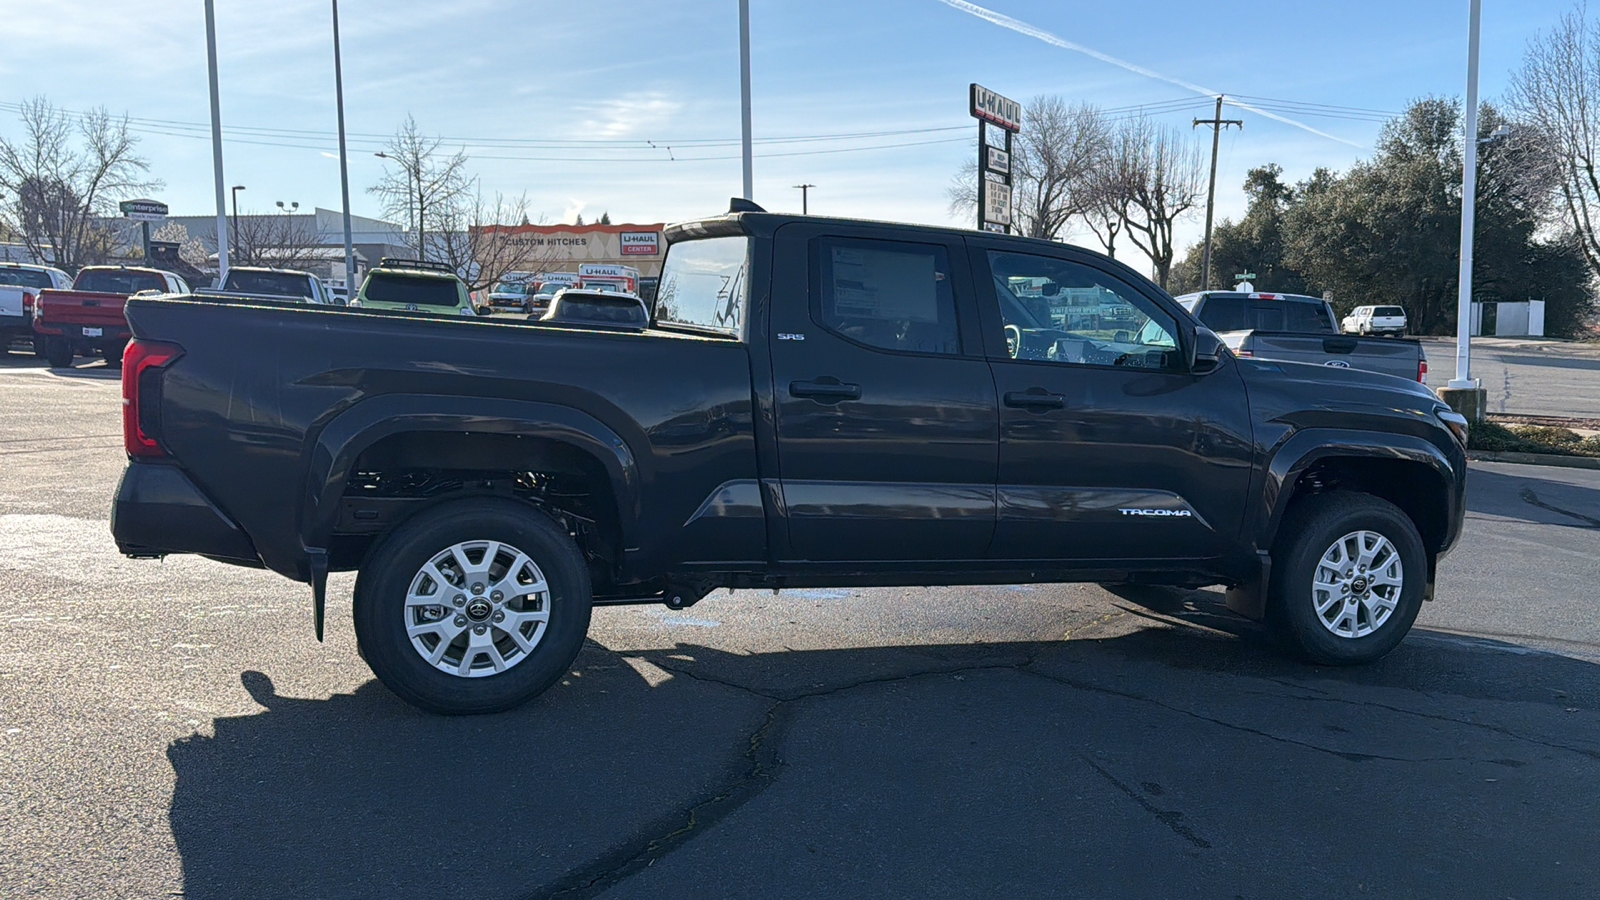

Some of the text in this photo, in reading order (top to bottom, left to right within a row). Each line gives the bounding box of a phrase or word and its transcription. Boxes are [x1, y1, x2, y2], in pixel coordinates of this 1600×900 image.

[977, 88, 1020, 123] U-HAUL
[126, 203, 168, 213] enterprise
[506, 238, 587, 246] CUSTOM HITCHES
[623, 235, 655, 243] U-HAUL
[1118, 508, 1192, 517] TACOMA
